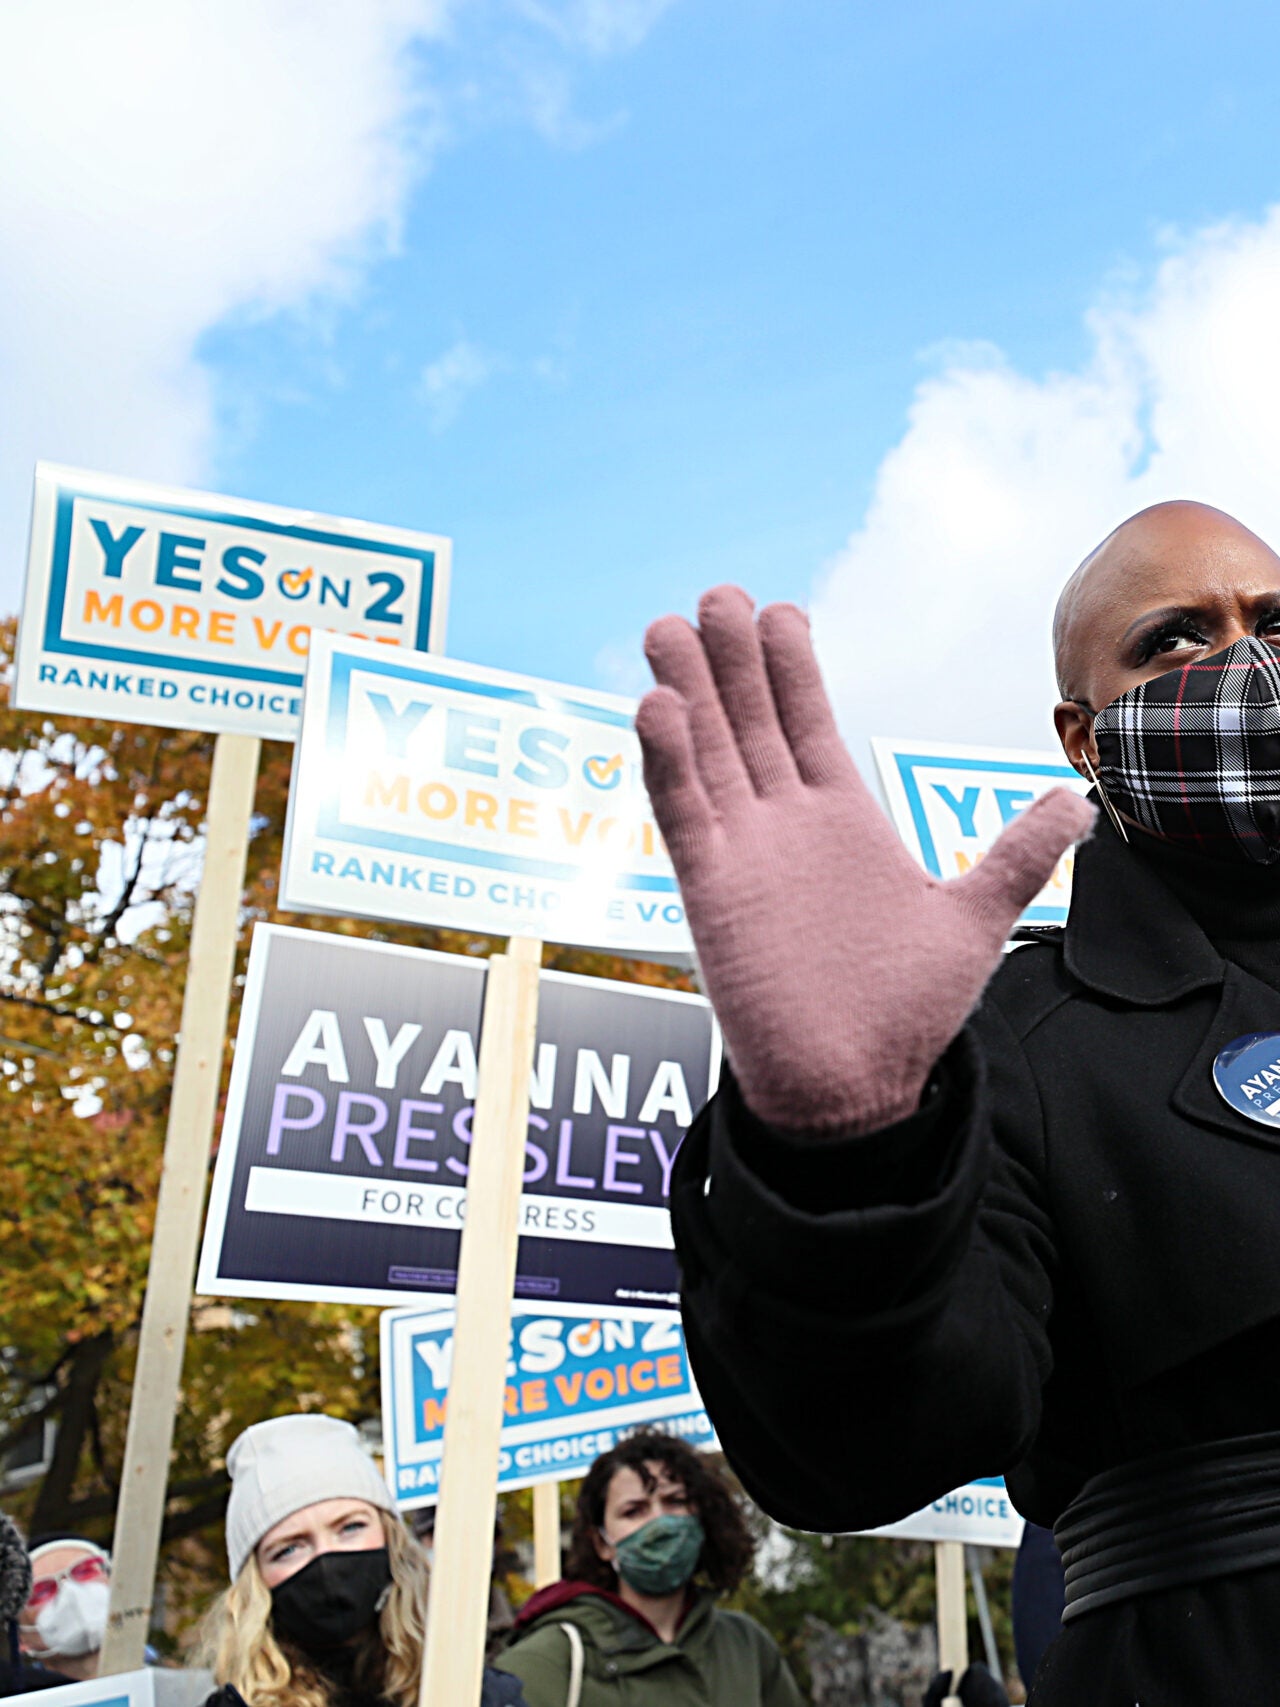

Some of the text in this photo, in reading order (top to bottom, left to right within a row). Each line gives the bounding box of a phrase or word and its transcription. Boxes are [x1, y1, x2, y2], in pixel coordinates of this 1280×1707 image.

[88, 517, 406, 625] YES ON 2
[82, 589, 237, 645] MORE
[38, 663, 301, 716] RANKED CHOICE
[365, 690, 571, 790] YES
[361, 770, 540, 839] MORE
[928, 783, 1036, 838] YE
[310, 850, 477, 899] RANKED
[361, 1189, 596, 1233] FOR CRESS
[415, 1319, 566, 1391] YS
[567, 1319, 635, 1358] ON
[423, 1354, 683, 1432] MRE VOICE
[514, 1430, 614, 1468] CHOICE
